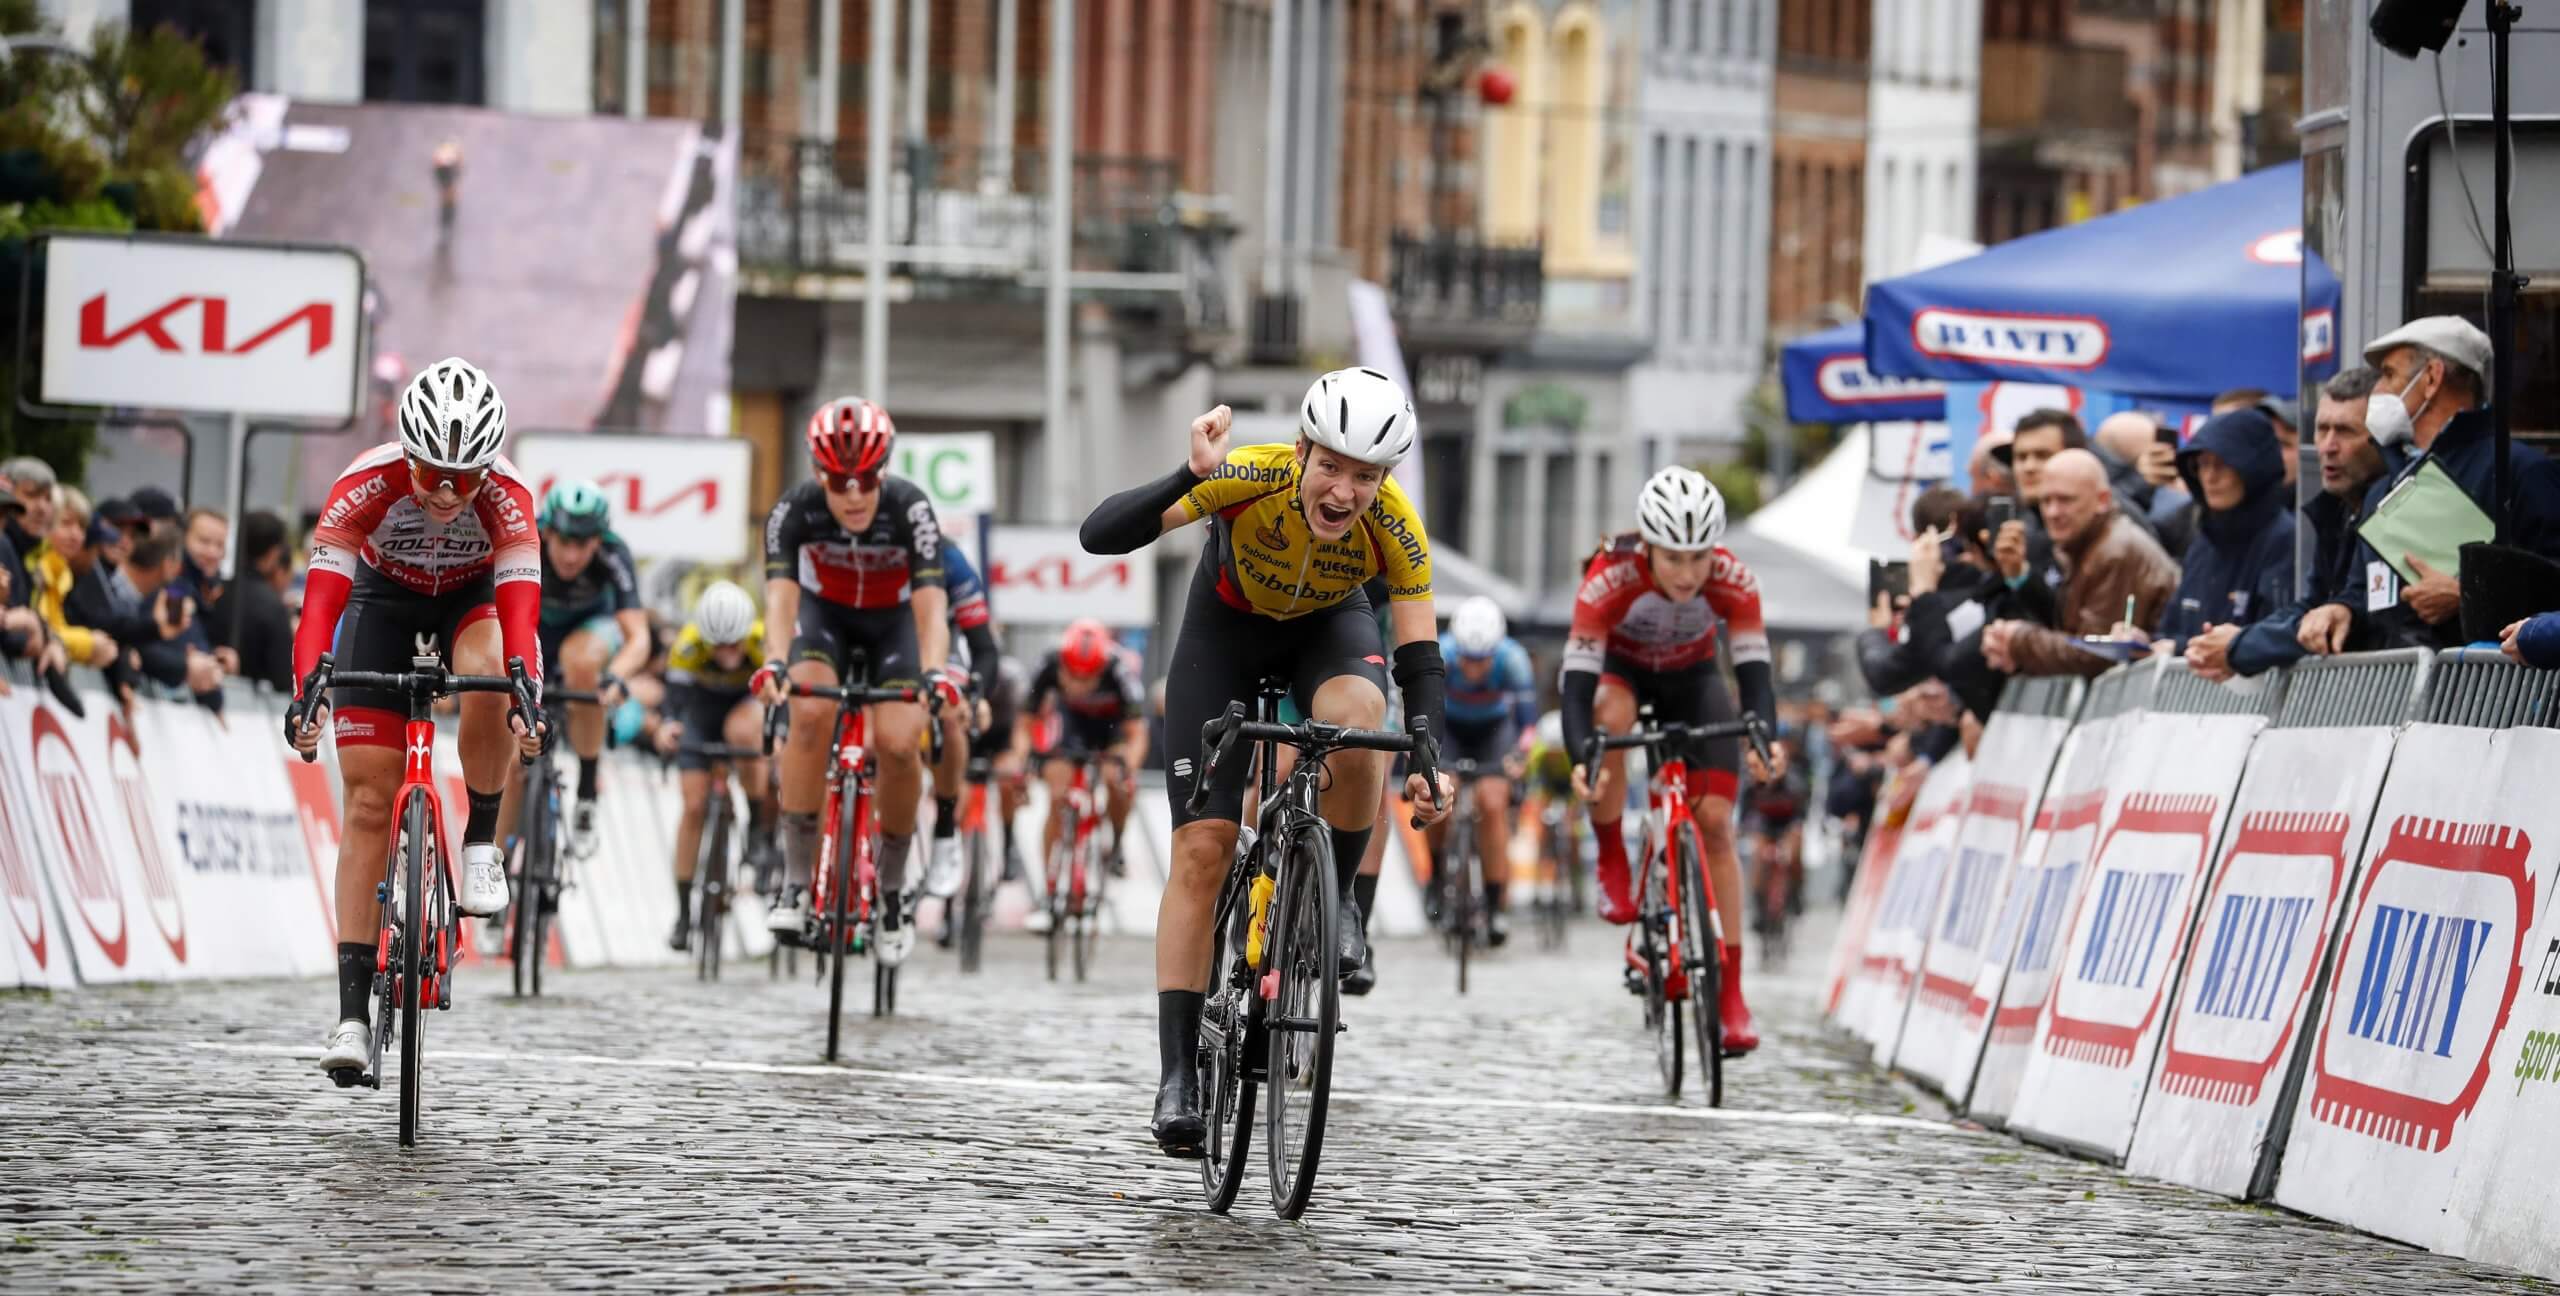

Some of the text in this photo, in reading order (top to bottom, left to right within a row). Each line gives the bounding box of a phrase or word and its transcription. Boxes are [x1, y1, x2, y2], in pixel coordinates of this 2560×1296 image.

[79, 290, 335, 357] KIA
[1210, 461, 1291, 483] abobank
[320, 497, 352, 529] VAN
[347, 474, 388, 513] EYCK
[1241, 544, 1294, 571] Rabobank
[2347, 904, 2493, 1059] WANTY
